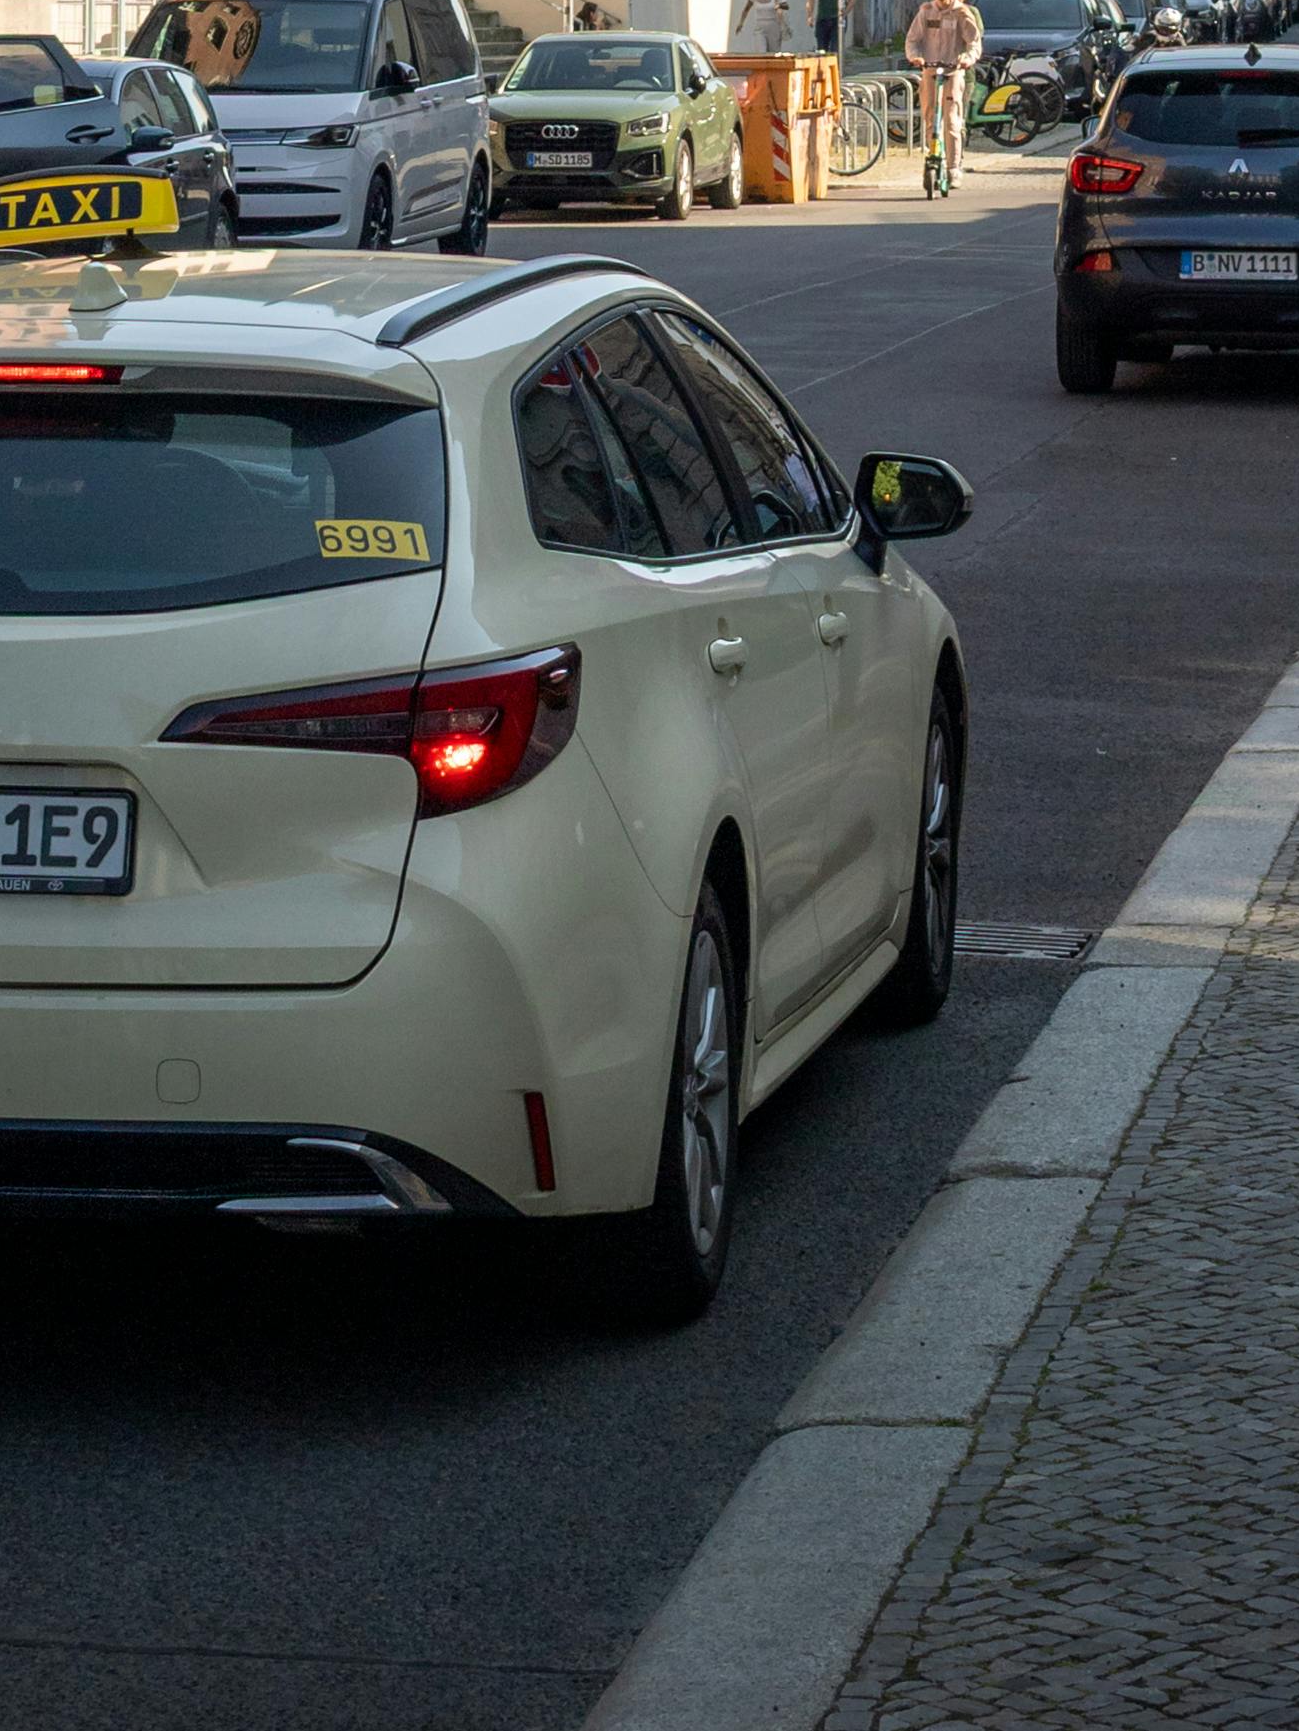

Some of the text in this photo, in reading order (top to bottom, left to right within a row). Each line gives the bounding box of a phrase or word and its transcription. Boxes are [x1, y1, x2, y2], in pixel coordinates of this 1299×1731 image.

[1201, 190, 1278, 200] KADJAR
[1193, 254, 1293, 273] B NV 1111
[318, 524, 423, 556] 6991
